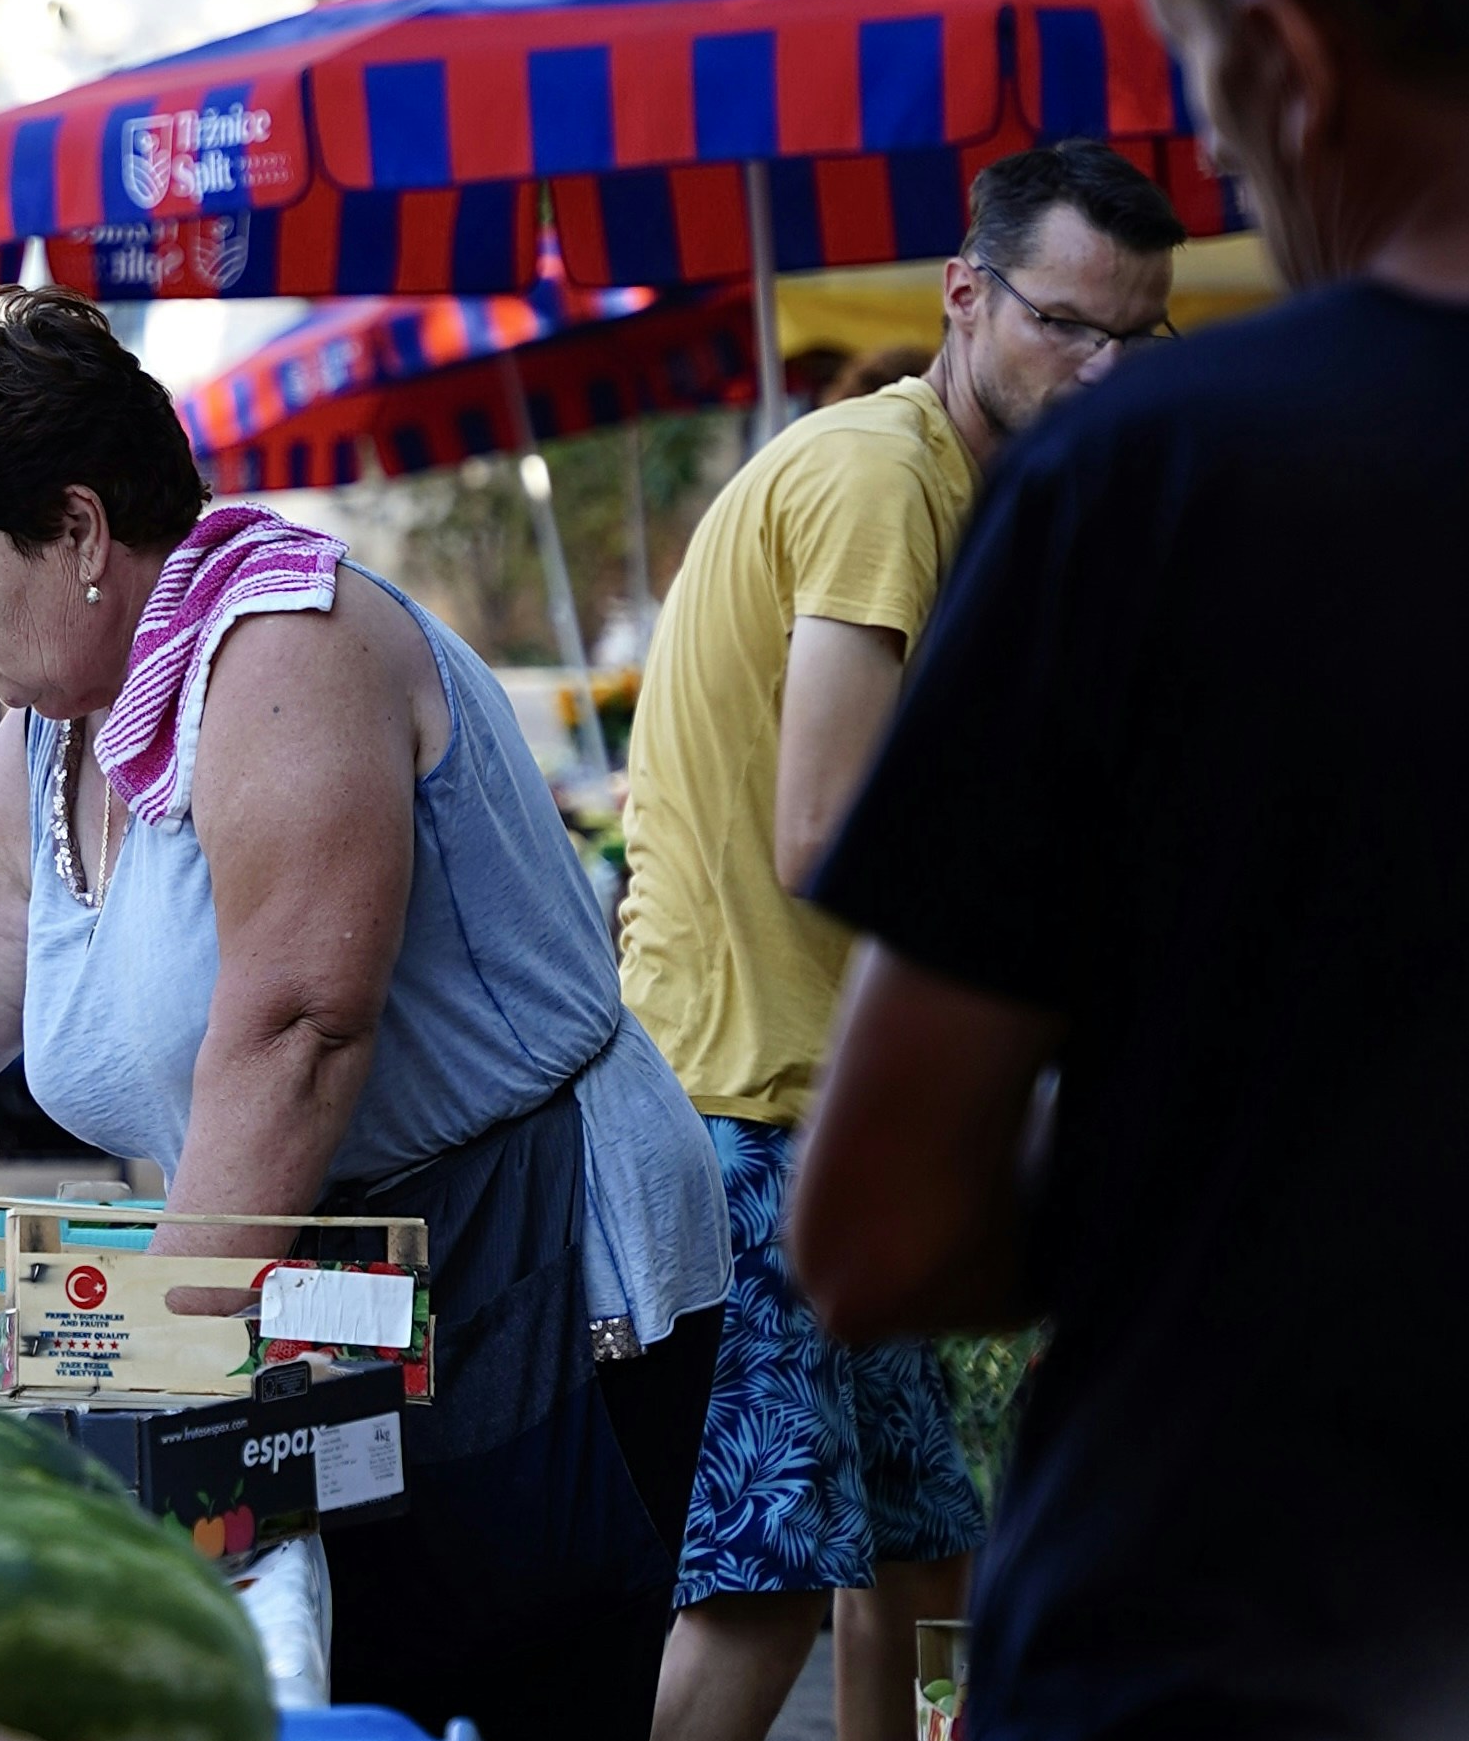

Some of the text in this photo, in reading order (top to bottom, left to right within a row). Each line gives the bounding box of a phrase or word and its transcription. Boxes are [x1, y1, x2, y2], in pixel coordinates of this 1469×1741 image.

[173, 102, 272, 152] Tržnice
[171, 149, 236, 204] Split
[73, 1313, 125, 1321] VEGETABLES
[80, 1320, 109, 1328] FRUITS
[243, 1424, 327, 1474] espax
